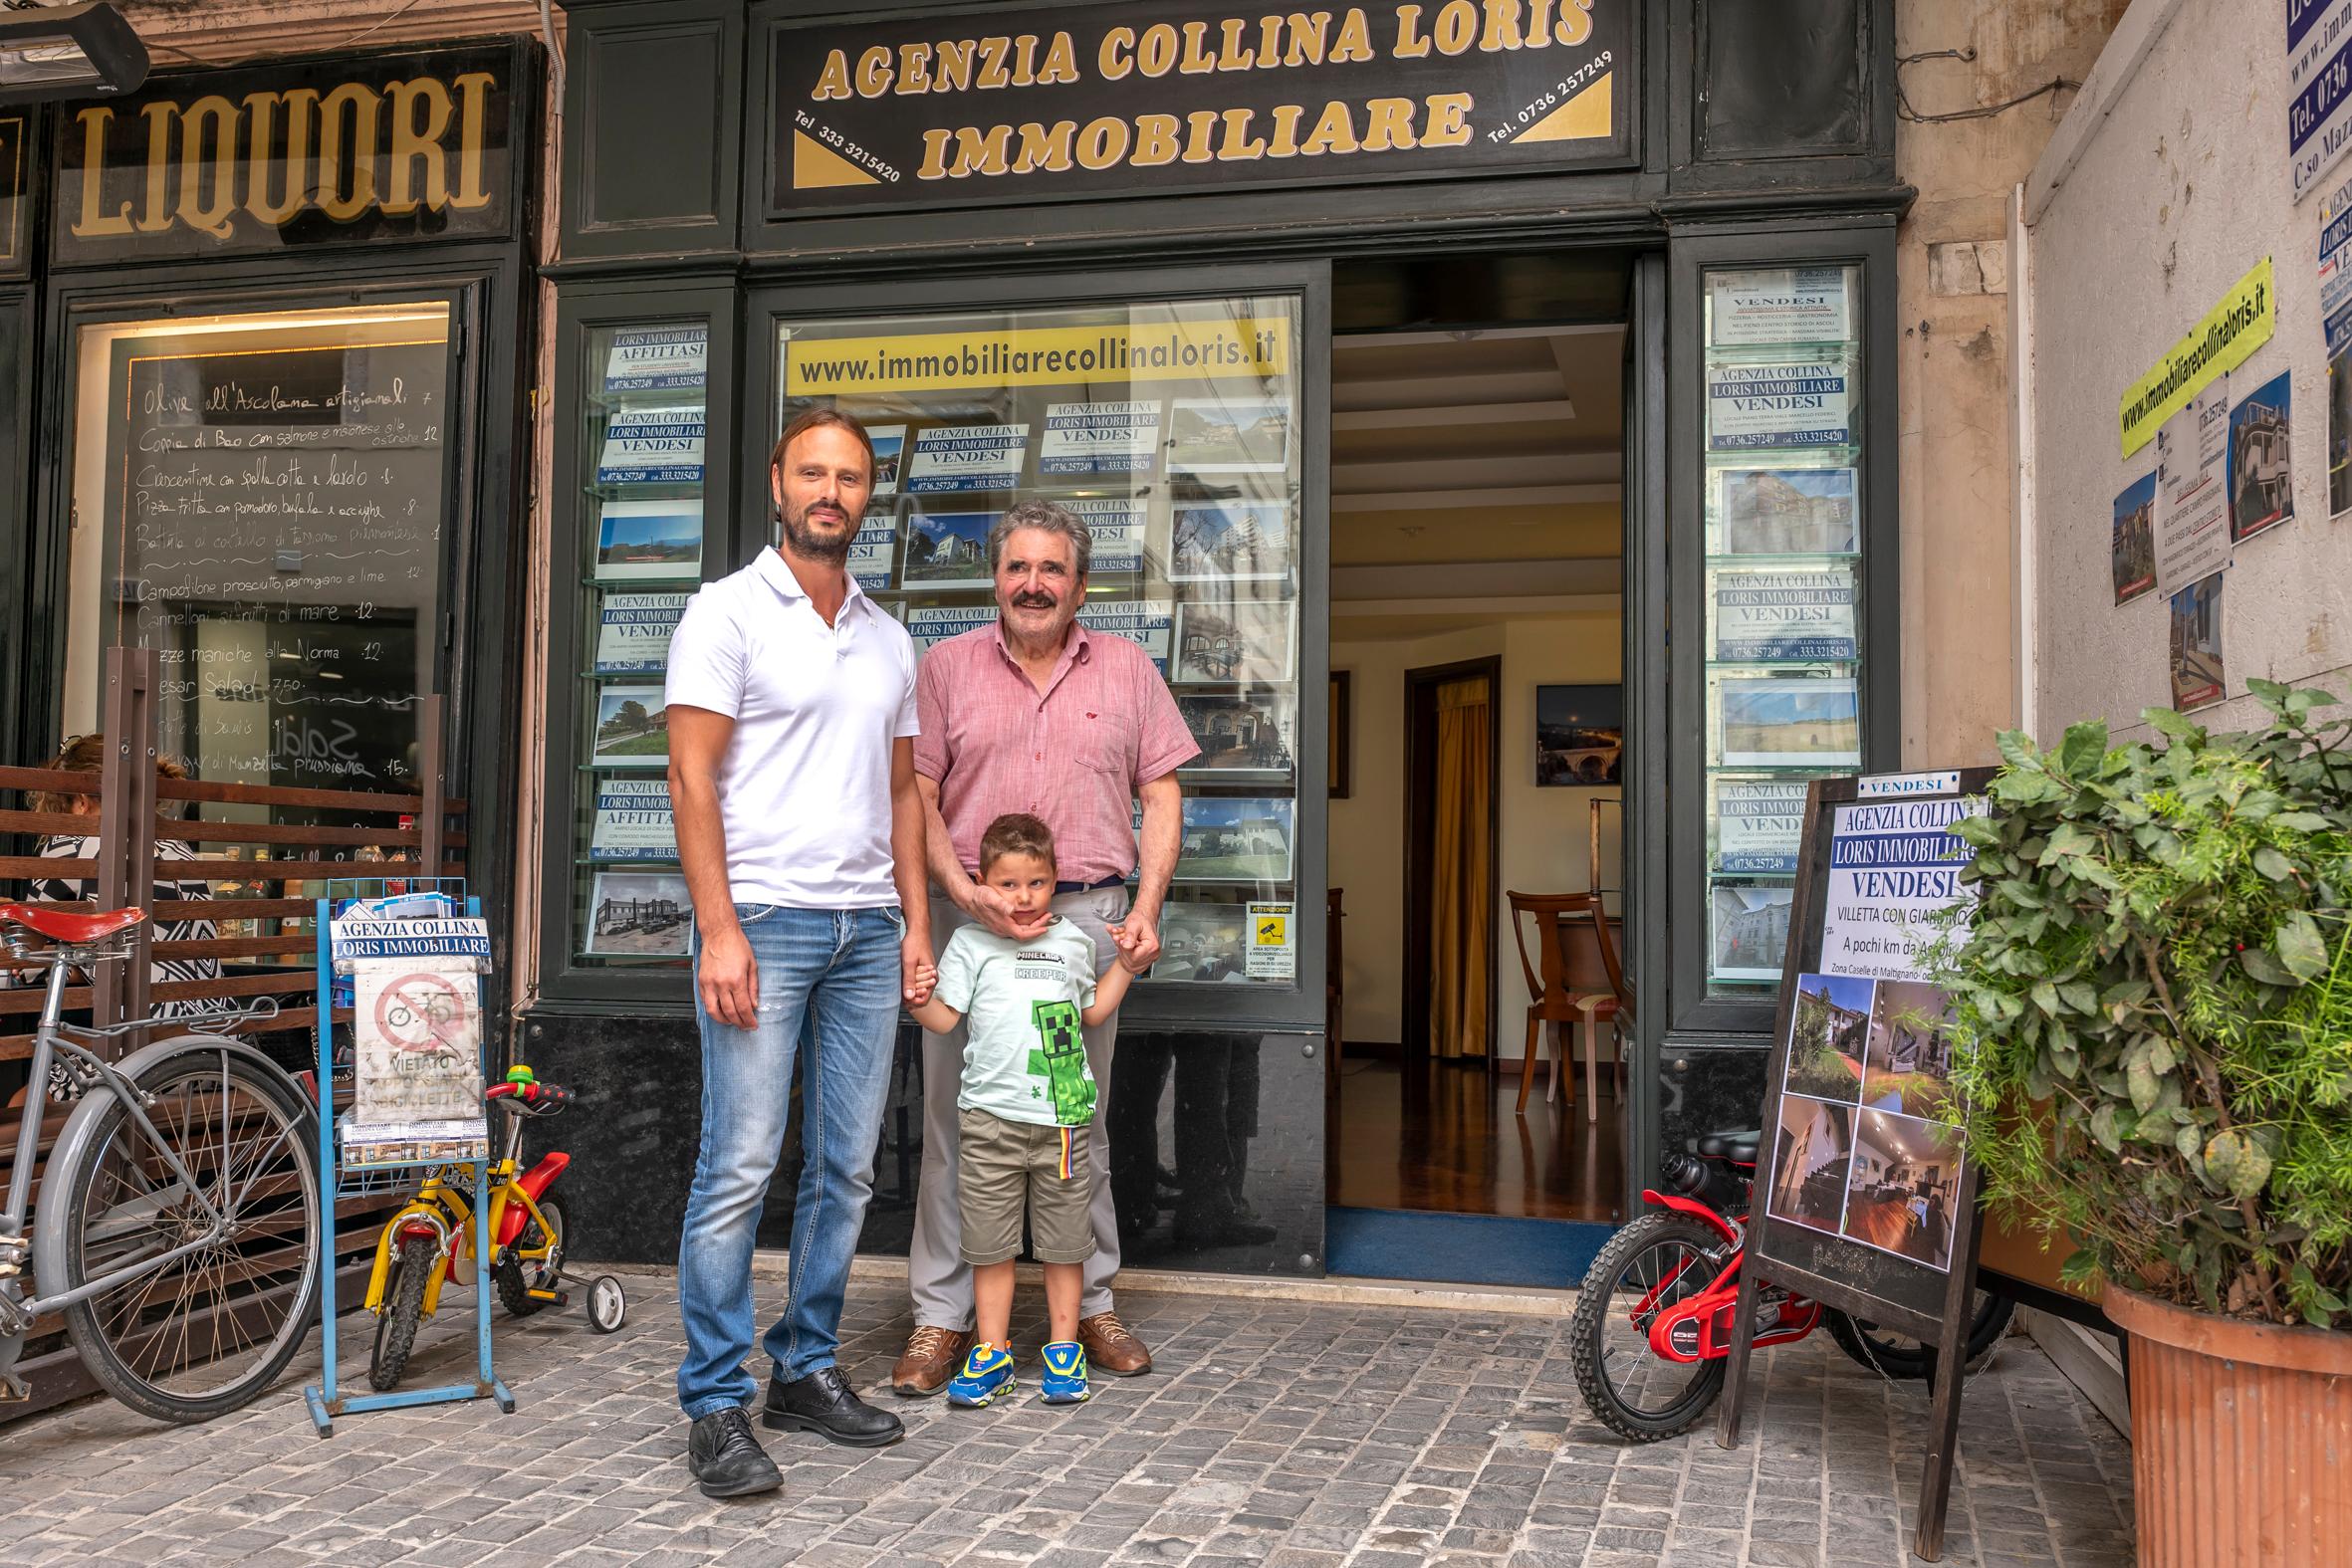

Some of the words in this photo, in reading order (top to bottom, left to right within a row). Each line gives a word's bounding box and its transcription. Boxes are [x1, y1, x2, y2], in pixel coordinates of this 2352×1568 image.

[811, 31, 1080, 102] AGENZIA
[1097, 8, 1375, 81] COLLINA
[1392, 0, 1592, 59] LORIS
[1487, 121, 1518, 144] Tel.
[1518, 91, 1556, 125] 0736
[1556, 50, 1613, 96] 257249
[2291, 95, 2314, 141] Tel.
[2317, 52, 2348, 112] 0736
[917, 92, 1474, 180] IMMOBILIARE
[795, 110, 815, 130] Tel
[819, 125, 844, 149] 333
[844, 141, 900, 183] 3215420
[71, 72, 496, 240] LIQUORI
[2294, 153, 2319, 190] C.so
[1733, 297, 1825, 306] VENDESI
[615, 335, 644, 345] LORIS
[646, 332, 707, 344] IMMOBILIAR
[619, 343, 704, 359] AFFITTASI
[800, 330, 1277, 383] www.immobiliarecollinaloris.it
[2122, 282, 2265, 433] www.immobiliarecollinaloris.it
[1721, 367, 1773, 381] AGENZIA
[1777, 365, 1832, 379] COLLINA
[1715, 383, 1752, 397] LORIS
[1754, 380, 1840, 395] IMMOBILIARE
[144, 382, 193, 414] Olive
[1733, 395, 1824, 411] VENDESI
[1056, 405, 1101, 415] AGENZIA
[1105, 402, 1151, 413] COLLINA
[618, 414, 660, 425] AGENZIA
[1049, 418, 1079, 429] LORIS
[1082, 415, 1155, 428] IMMOBILIARE
[610, 427, 639, 438] LORIS
[926, 428, 972, 439] AGENZIA
[974, 426, 1019, 437] COLLINA
[1063, 429, 1139, 441] VENDESI
[1726, 434, 1775, 446] 0736.257249
[1793, 431, 1843, 443] 333.3215420
[139, 428, 188, 455] Coppia
[195, 431, 206, 449] di
[424, 425, 438, 441] 12
[622, 439, 693, 451] VENDESI
[918, 441, 950, 452] LORIS
[952, 438, 1023, 450] IMMOBILIARE
[932, 451, 1006, 463] VENDESI
[1051, 462, 1091, 472] 0736.257249
[1107, 461, 1150, 470] 333.3215420
[917, 481, 958, 491] 0736.257249
[973, 479, 1015, 489] 333.3215420
[135, 491, 176, 516] Pizza
[1090, 501, 1136, 512] COLLINA
[862, 519, 886, 529] LINA
[1082, 514, 1141, 526] MOBILIARE
[360, 566, 386, 582] lime
[1729, 576, 1783, 588] AGENZIA
[1786, 574, 1841, 587] COLLINA
[612, 597, 655, 608] AGENZIA
[658, 595, 688, 607] COLLI
[1722, 592, 1759, 604] LORIS
[1762, 590, 1848, 604] IMMOBILIARE
[300, 605, 340, 621] mare
[1115, 602, 1162, 613] COLLINA
[1741, 607, 1831, 621] VENDESI
[605, 611, 635, 623] LORIS
[636, 610, 681, 622] IMMOBIL
[917, 609, 963, 621] AGENZIA
[910, 623, 941, 635] LORIS
[1093, 616, 1167, 629] IMMOBILIARE
[618, 625, 677, 637] VENDE
[191, 642, 253, 663] maniche
[297, 637, 340, 661] Norma
[1733, 646, 1781, 658] 0736.257249
[1800, 646, 1849, 657] 333.3215420
[159, 679, 196, 695] esar
[205, 670, 258, 695] Salad
[609, 783, 652, 793] AGENZIA
[1729, 785, 1782, 797] AGENZIA
[1871, 780, 1943, 793] VENDESI
[601, 797, 630, 808] LORIS
[1723, 801, 1760, 815] LORIS
[605, 811, 674, 824] AFFITTA
[1845, 804, 1904, 831] AGENZIA
[1909, 800, 1967, 828] COLLIN
[1742, 817, 1801, 830] VEND
[1835, 840, 1875, 864] LORIS
[1735, 857, 1783, 869] 0736.257249
[1852, 871, 1958, 898] VENDESI
[1837, 906, 1880, 923] VILLETTA
[1882, 908, 1906, 923] CON
[340, 922, 408, 937] AGENZIA
[412, 921, 480, 935] COLLINA
[334, 941, 380, 957] LORIS
[383, 938, 490, 955] IMMOBILIARE
[1843, 937, 1851, 952] A
[1853, 936, 1881, 956] pochi
[1883, 937, 1900, 954] km
[1903, 939, 1917, 955] da
[1017, 951, 1066, 964] MINECRAFT
[1015, 967, 1066, 982] CREEPER
[1831, 963, 1847, 974] Zona
[1848, 965, 1871, 976] Caselle
[1872, 966, 1879, 976] di
